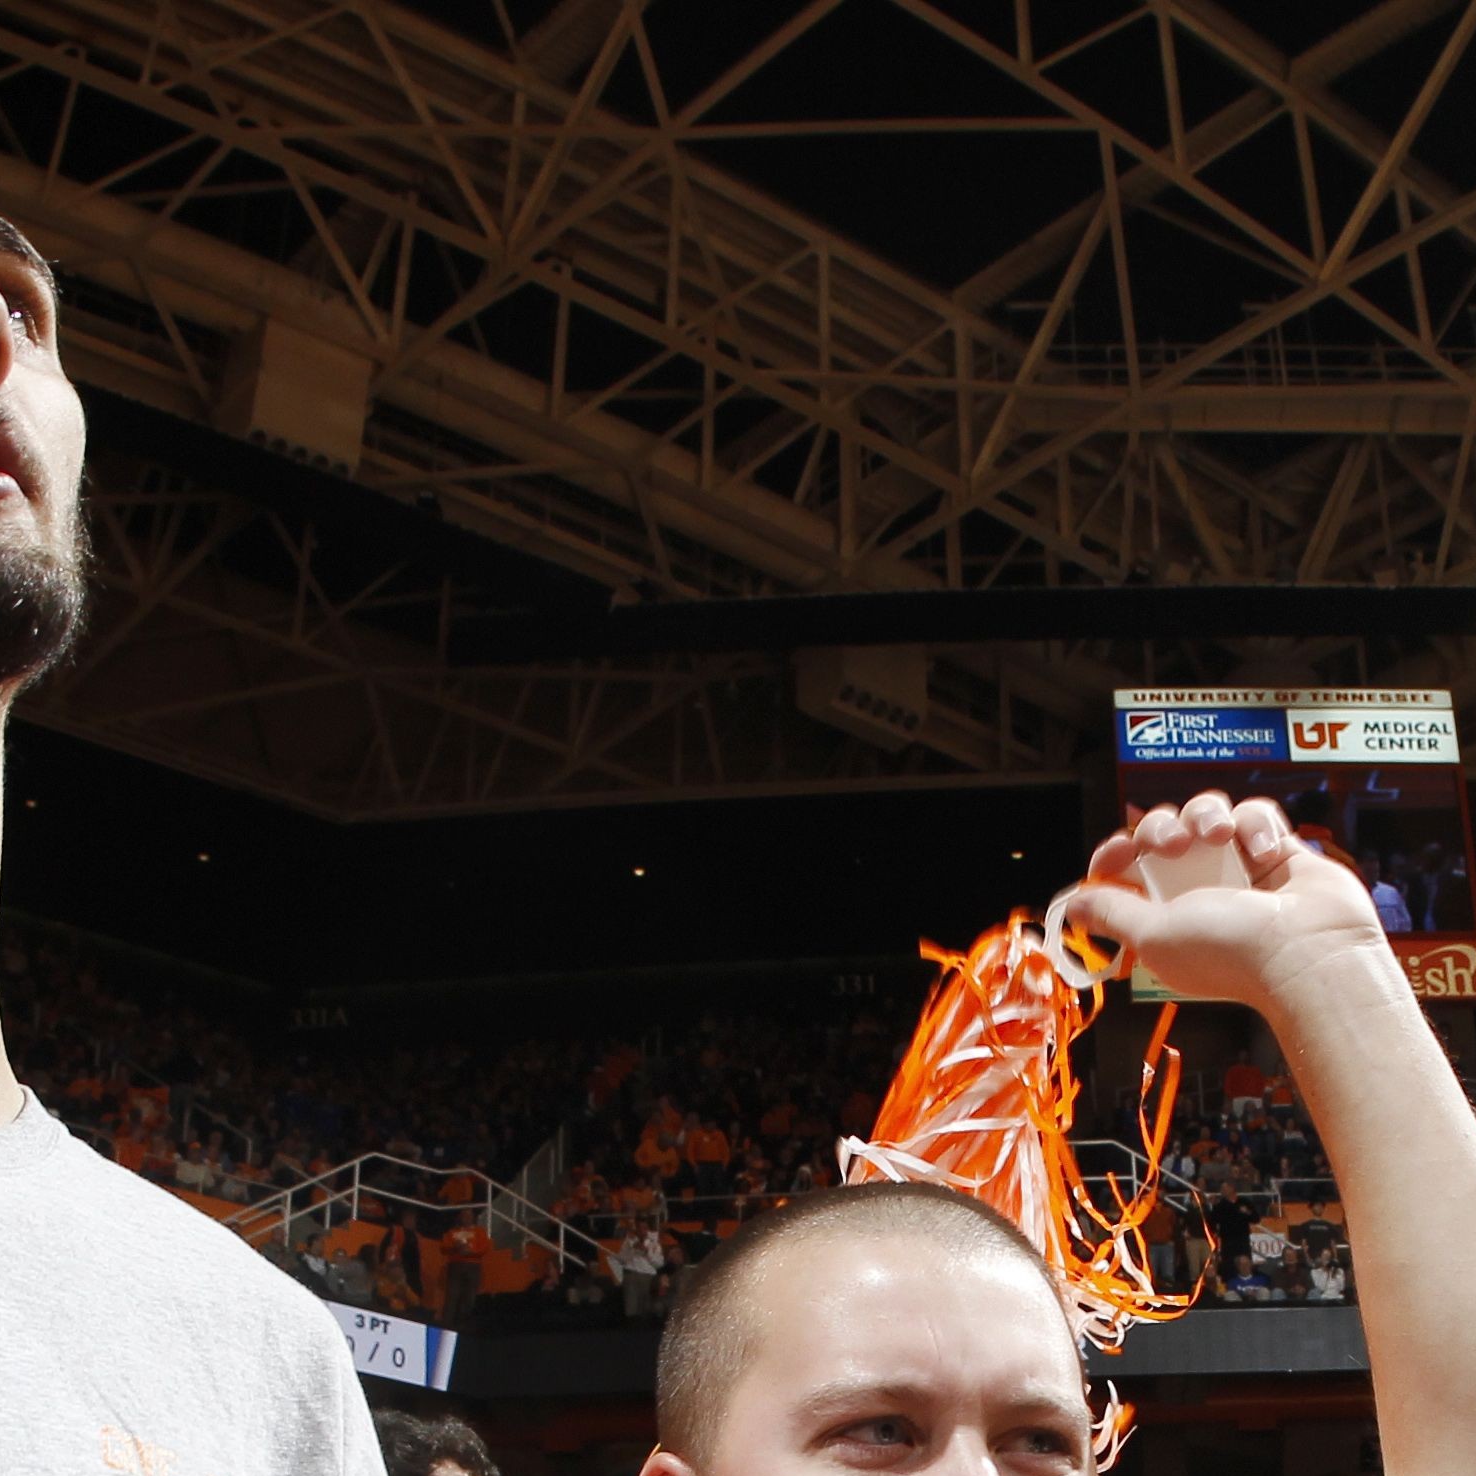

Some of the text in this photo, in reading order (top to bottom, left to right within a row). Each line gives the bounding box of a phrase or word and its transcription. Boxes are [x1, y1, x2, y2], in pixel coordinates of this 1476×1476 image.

[1132, 692, 1435, 703] UNIVERSITY OF TENNESSEE
[1292, 721, 1452, 750] UT MEDICAL
[1365, 737, 1440, 751] CENTER
[1135, 747, 1175, 760] Official
[1177, 747, 1205, 759] Bank
[1219, 747, 1235, 758] the
[355, 1314, 391, 1334] 3 PT
[392, 1347, 405, 1368] 0
